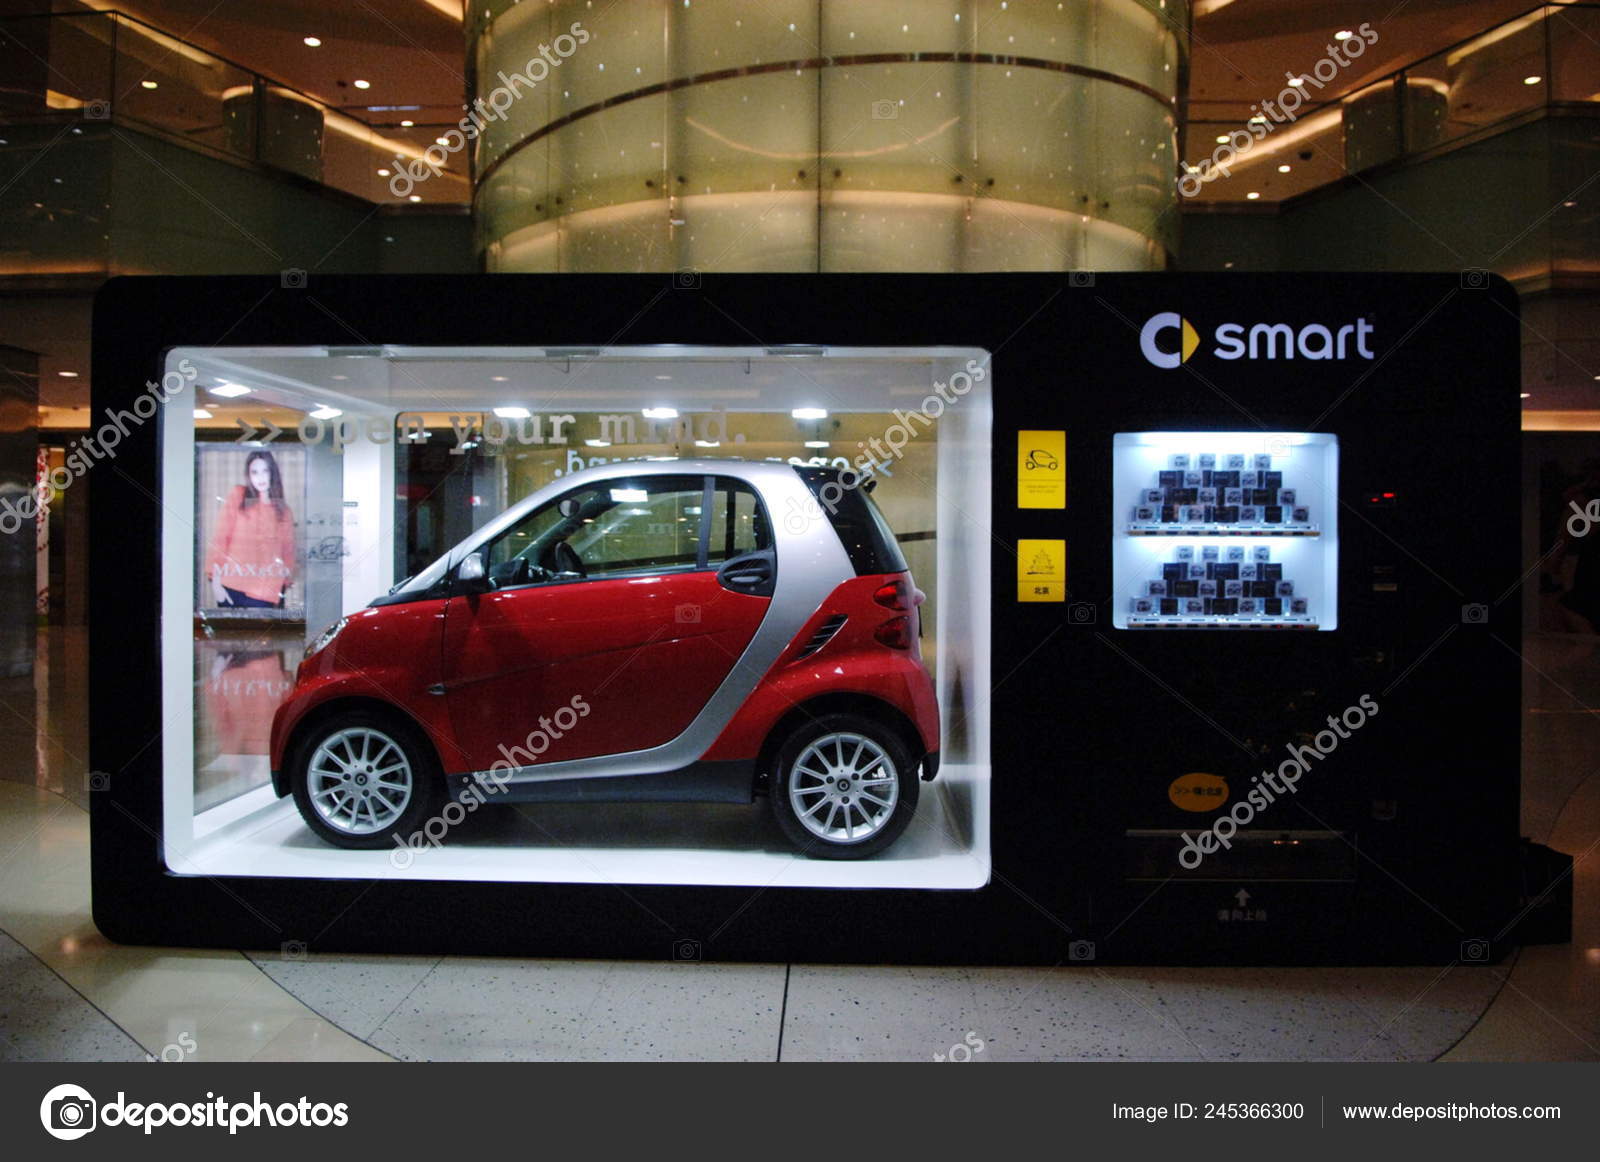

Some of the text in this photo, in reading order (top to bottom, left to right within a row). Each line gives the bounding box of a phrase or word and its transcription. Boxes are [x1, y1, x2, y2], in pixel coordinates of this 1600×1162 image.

[1213, 316, 1374, 361] smart
[296, 411, 427, 455] open
[449, 412, 576, 455] your
[598, 404, 746, 445] mind.
